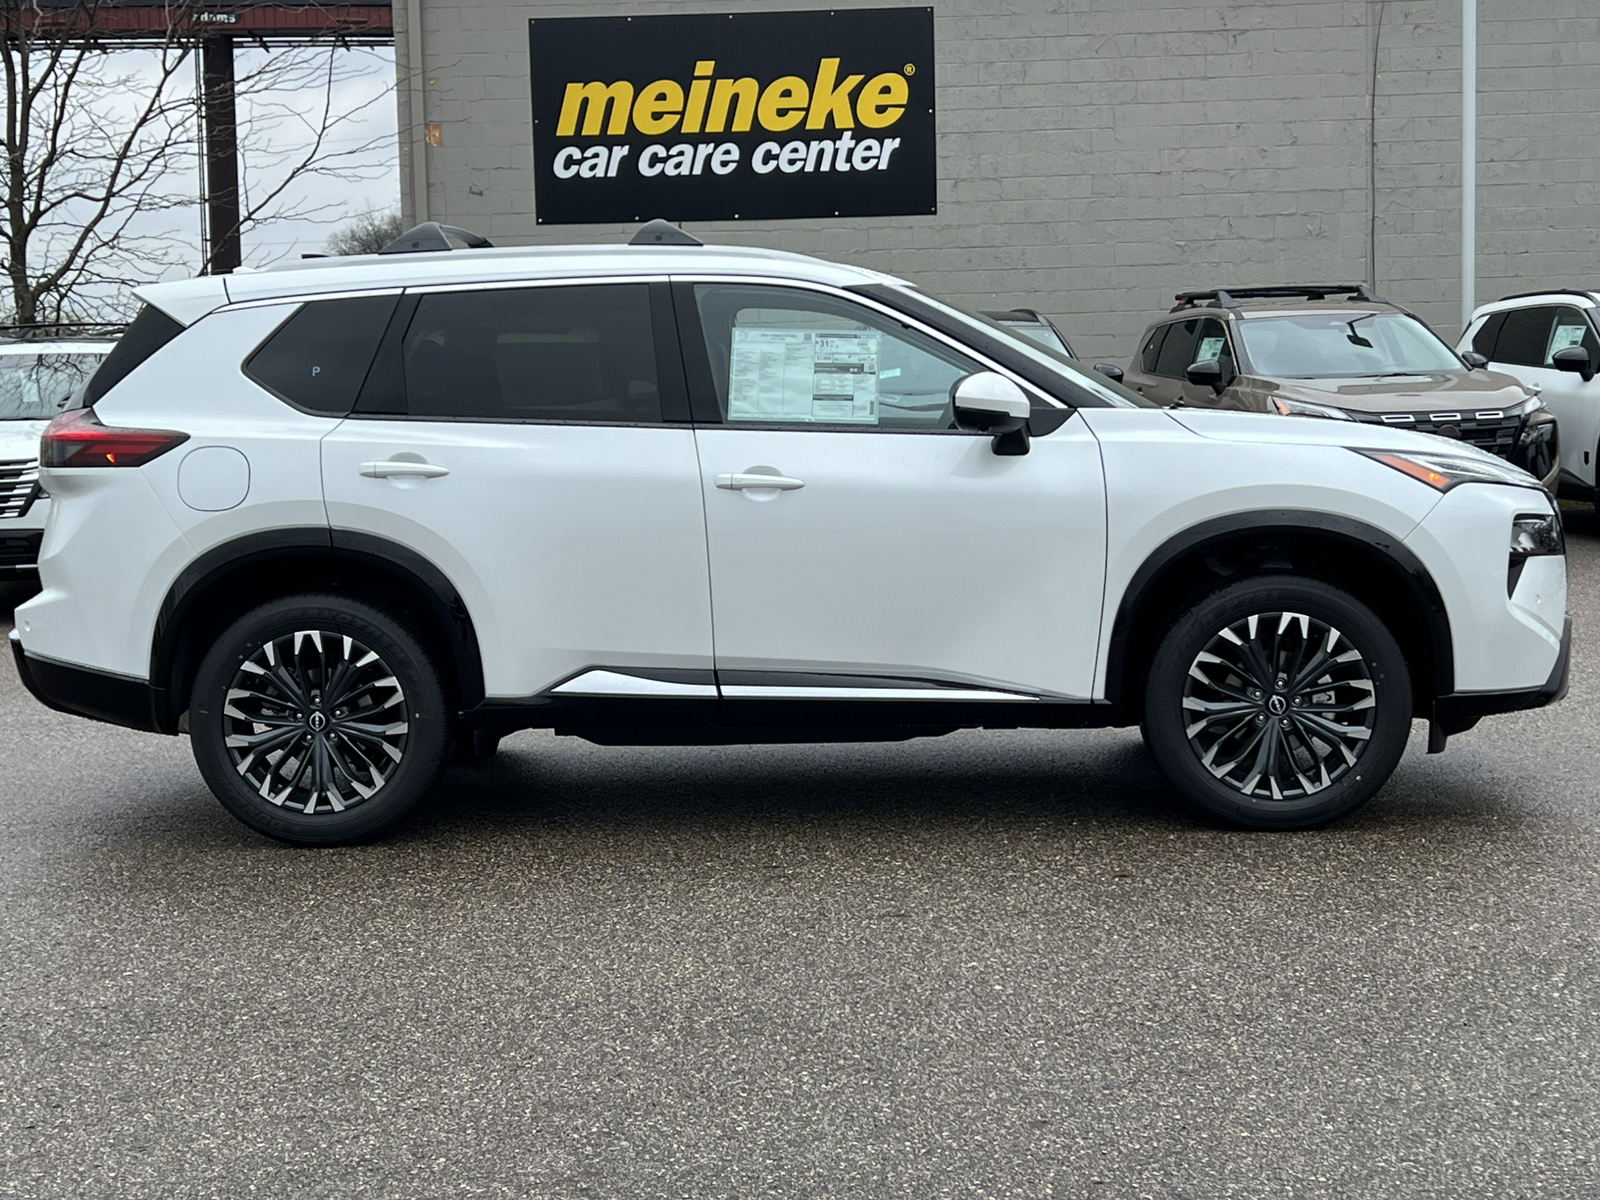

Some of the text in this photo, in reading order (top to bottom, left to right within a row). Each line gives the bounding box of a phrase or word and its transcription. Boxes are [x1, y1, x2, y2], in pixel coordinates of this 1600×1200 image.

[556, 57, 909, 137] meineke
[553, 130, 901, 179] car care center
[312, 365, 321, 377] P
